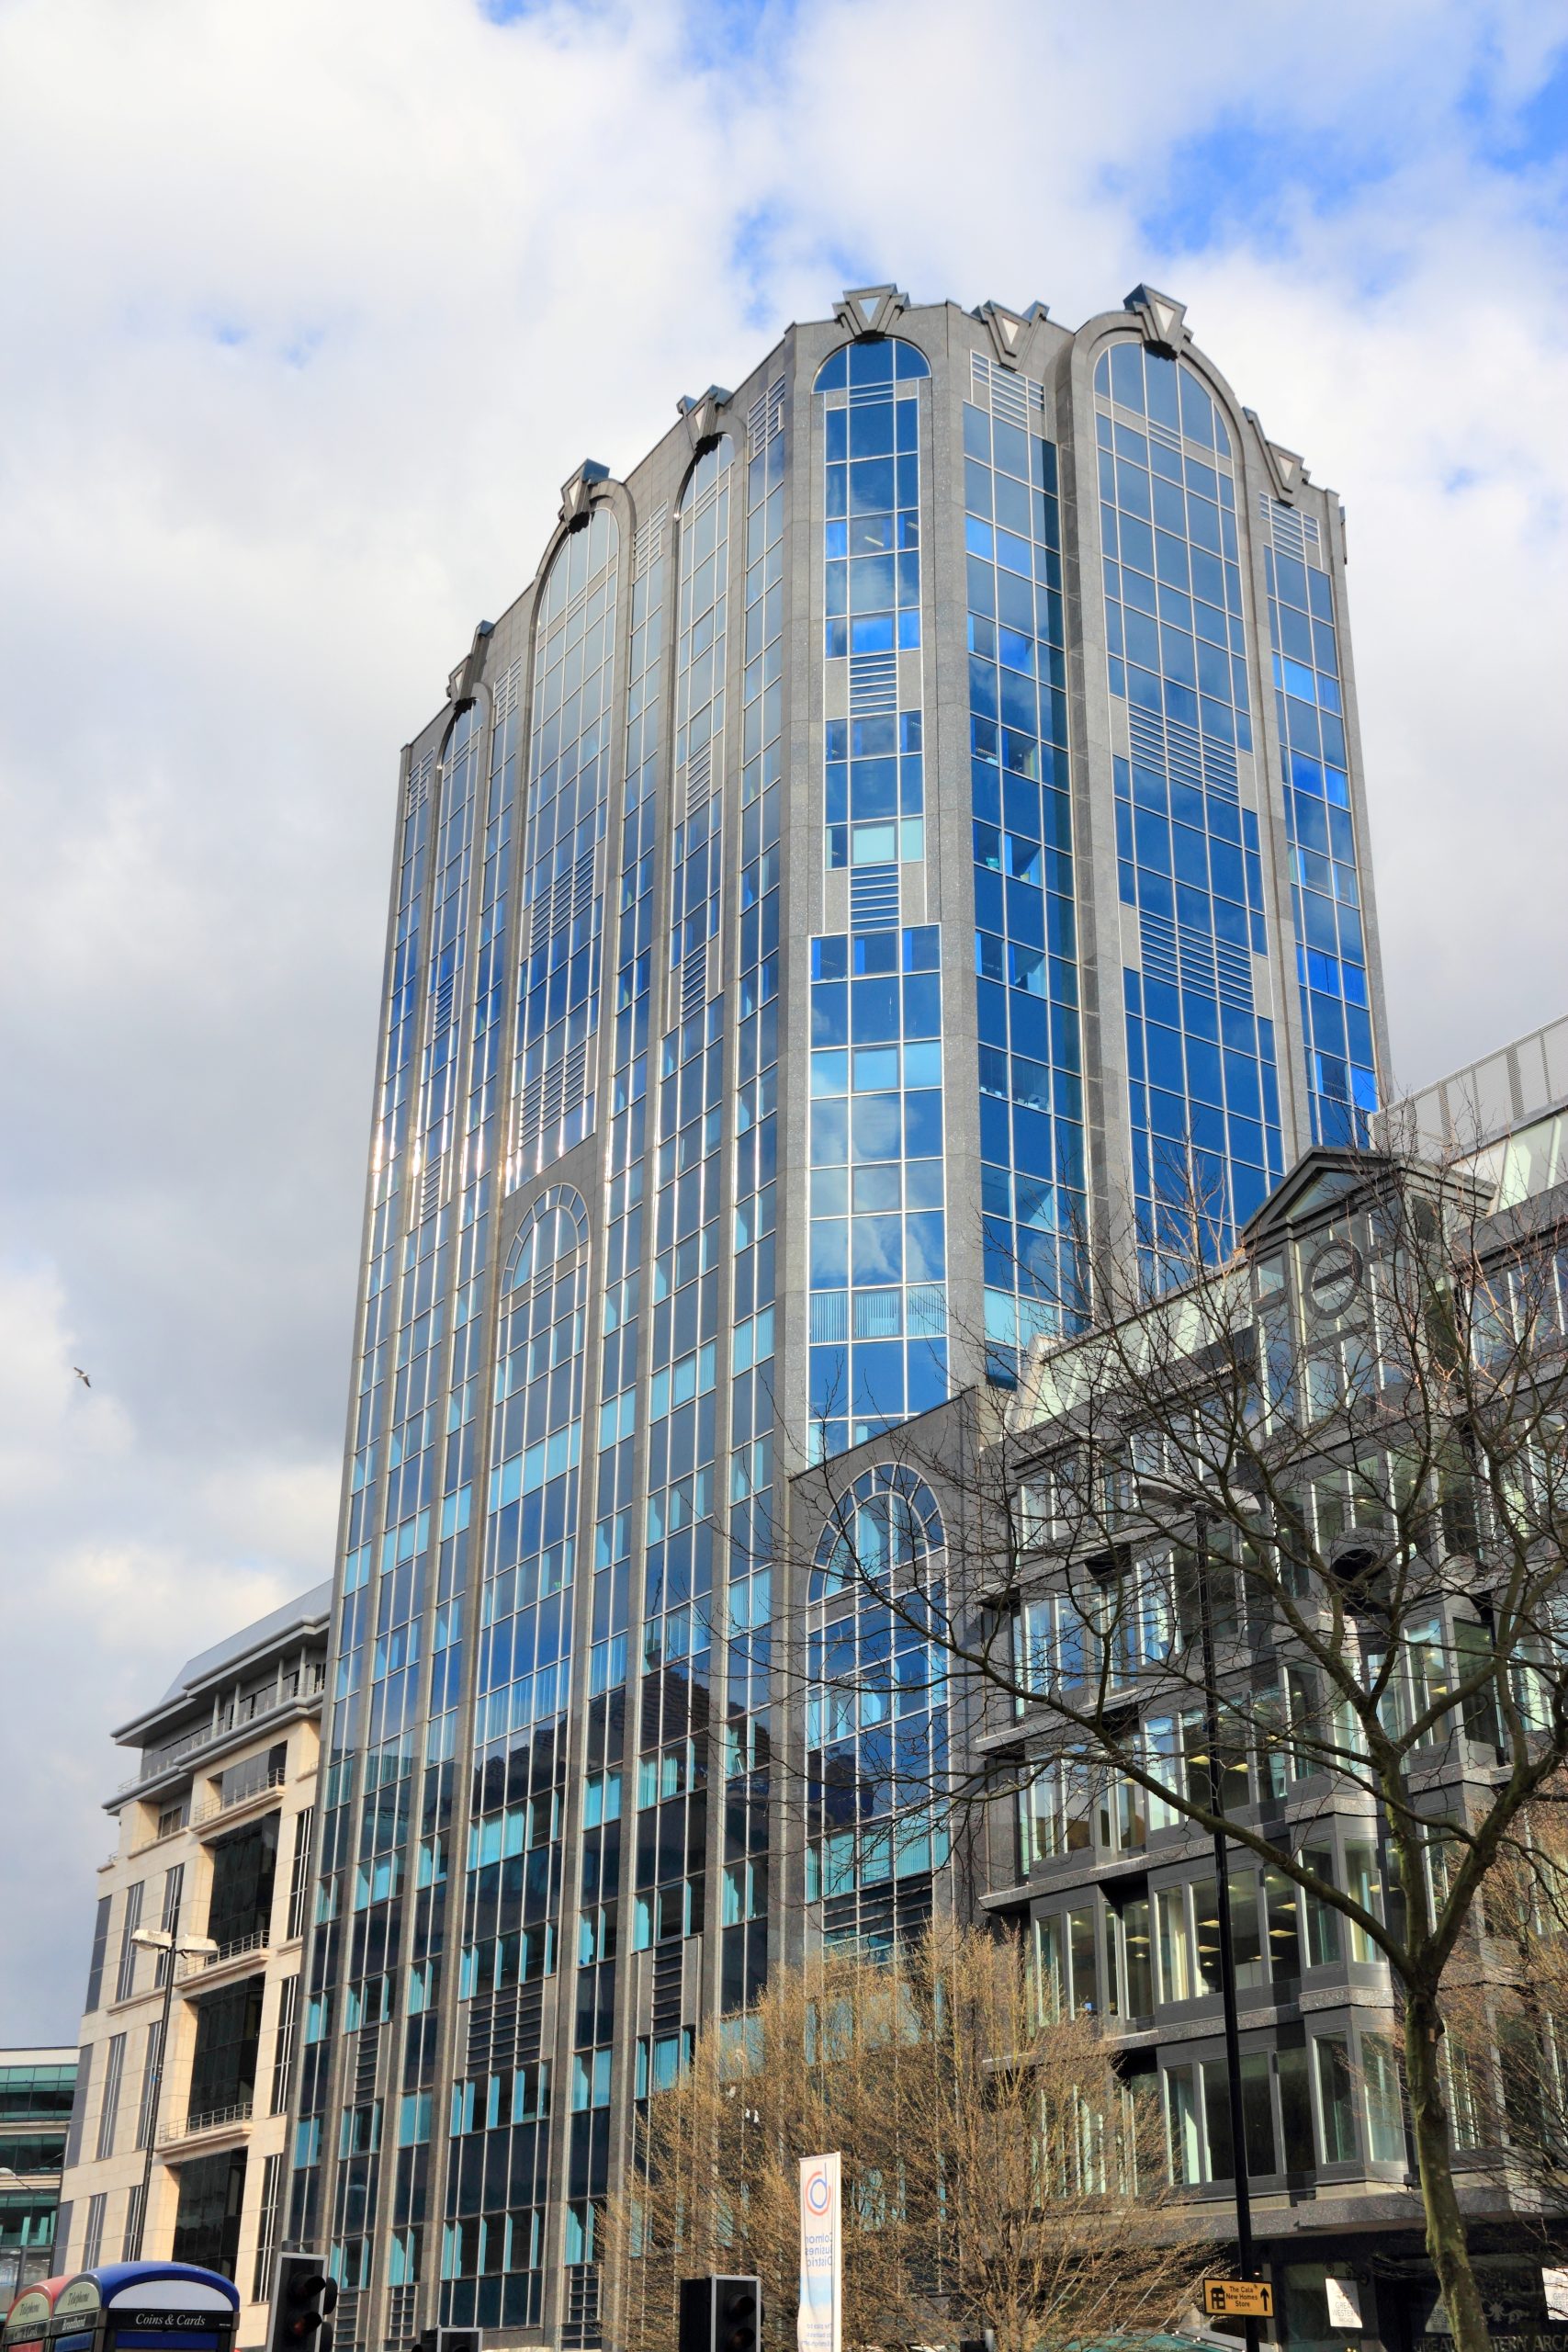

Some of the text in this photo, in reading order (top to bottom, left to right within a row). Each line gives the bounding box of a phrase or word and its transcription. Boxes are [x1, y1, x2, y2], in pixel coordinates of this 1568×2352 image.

[1335, 2301, 1353, 2310] GREA
[1332, 2309, 1358, 2317] WESTER
[136, 2313, 206, 2326] Coins & Cards
